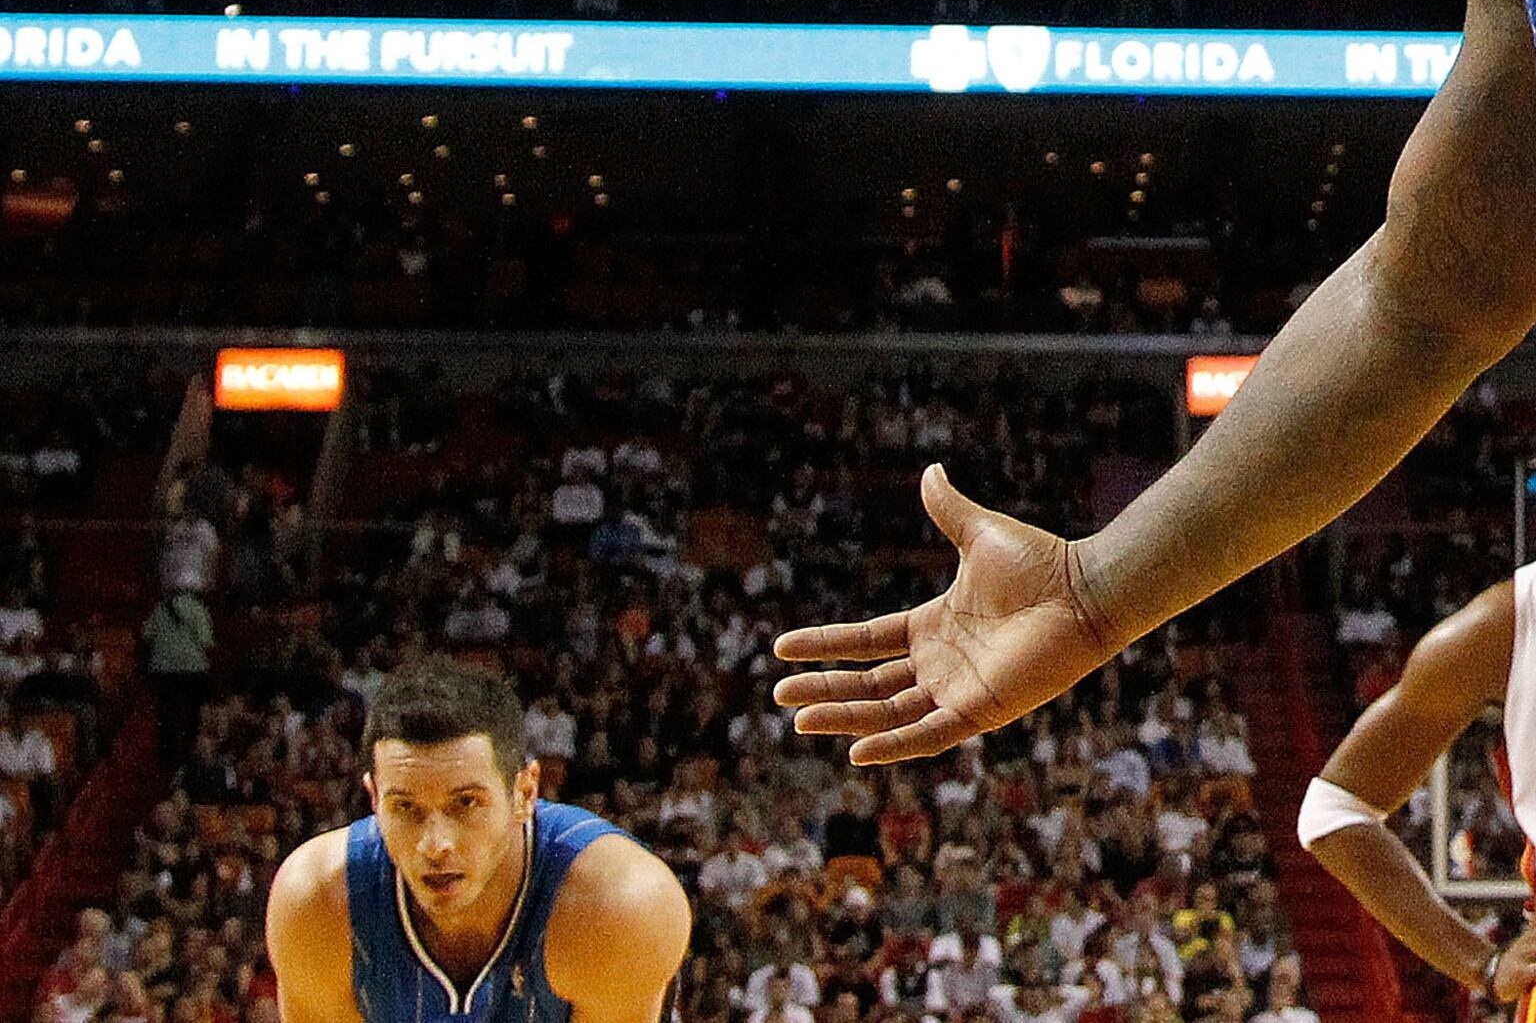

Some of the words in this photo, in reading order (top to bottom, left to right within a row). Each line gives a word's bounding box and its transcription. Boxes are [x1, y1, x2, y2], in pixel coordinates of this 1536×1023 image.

[0, 28, 140, 67] RIDA
[216, 29, 269, 71] IN
[279, 30, 371, 71] THE
[380, 32, 573, 73] PURSUIT
[1055, 41, 1275, 82] FLORIDA
[1346, 44, 1398, 83] IN
